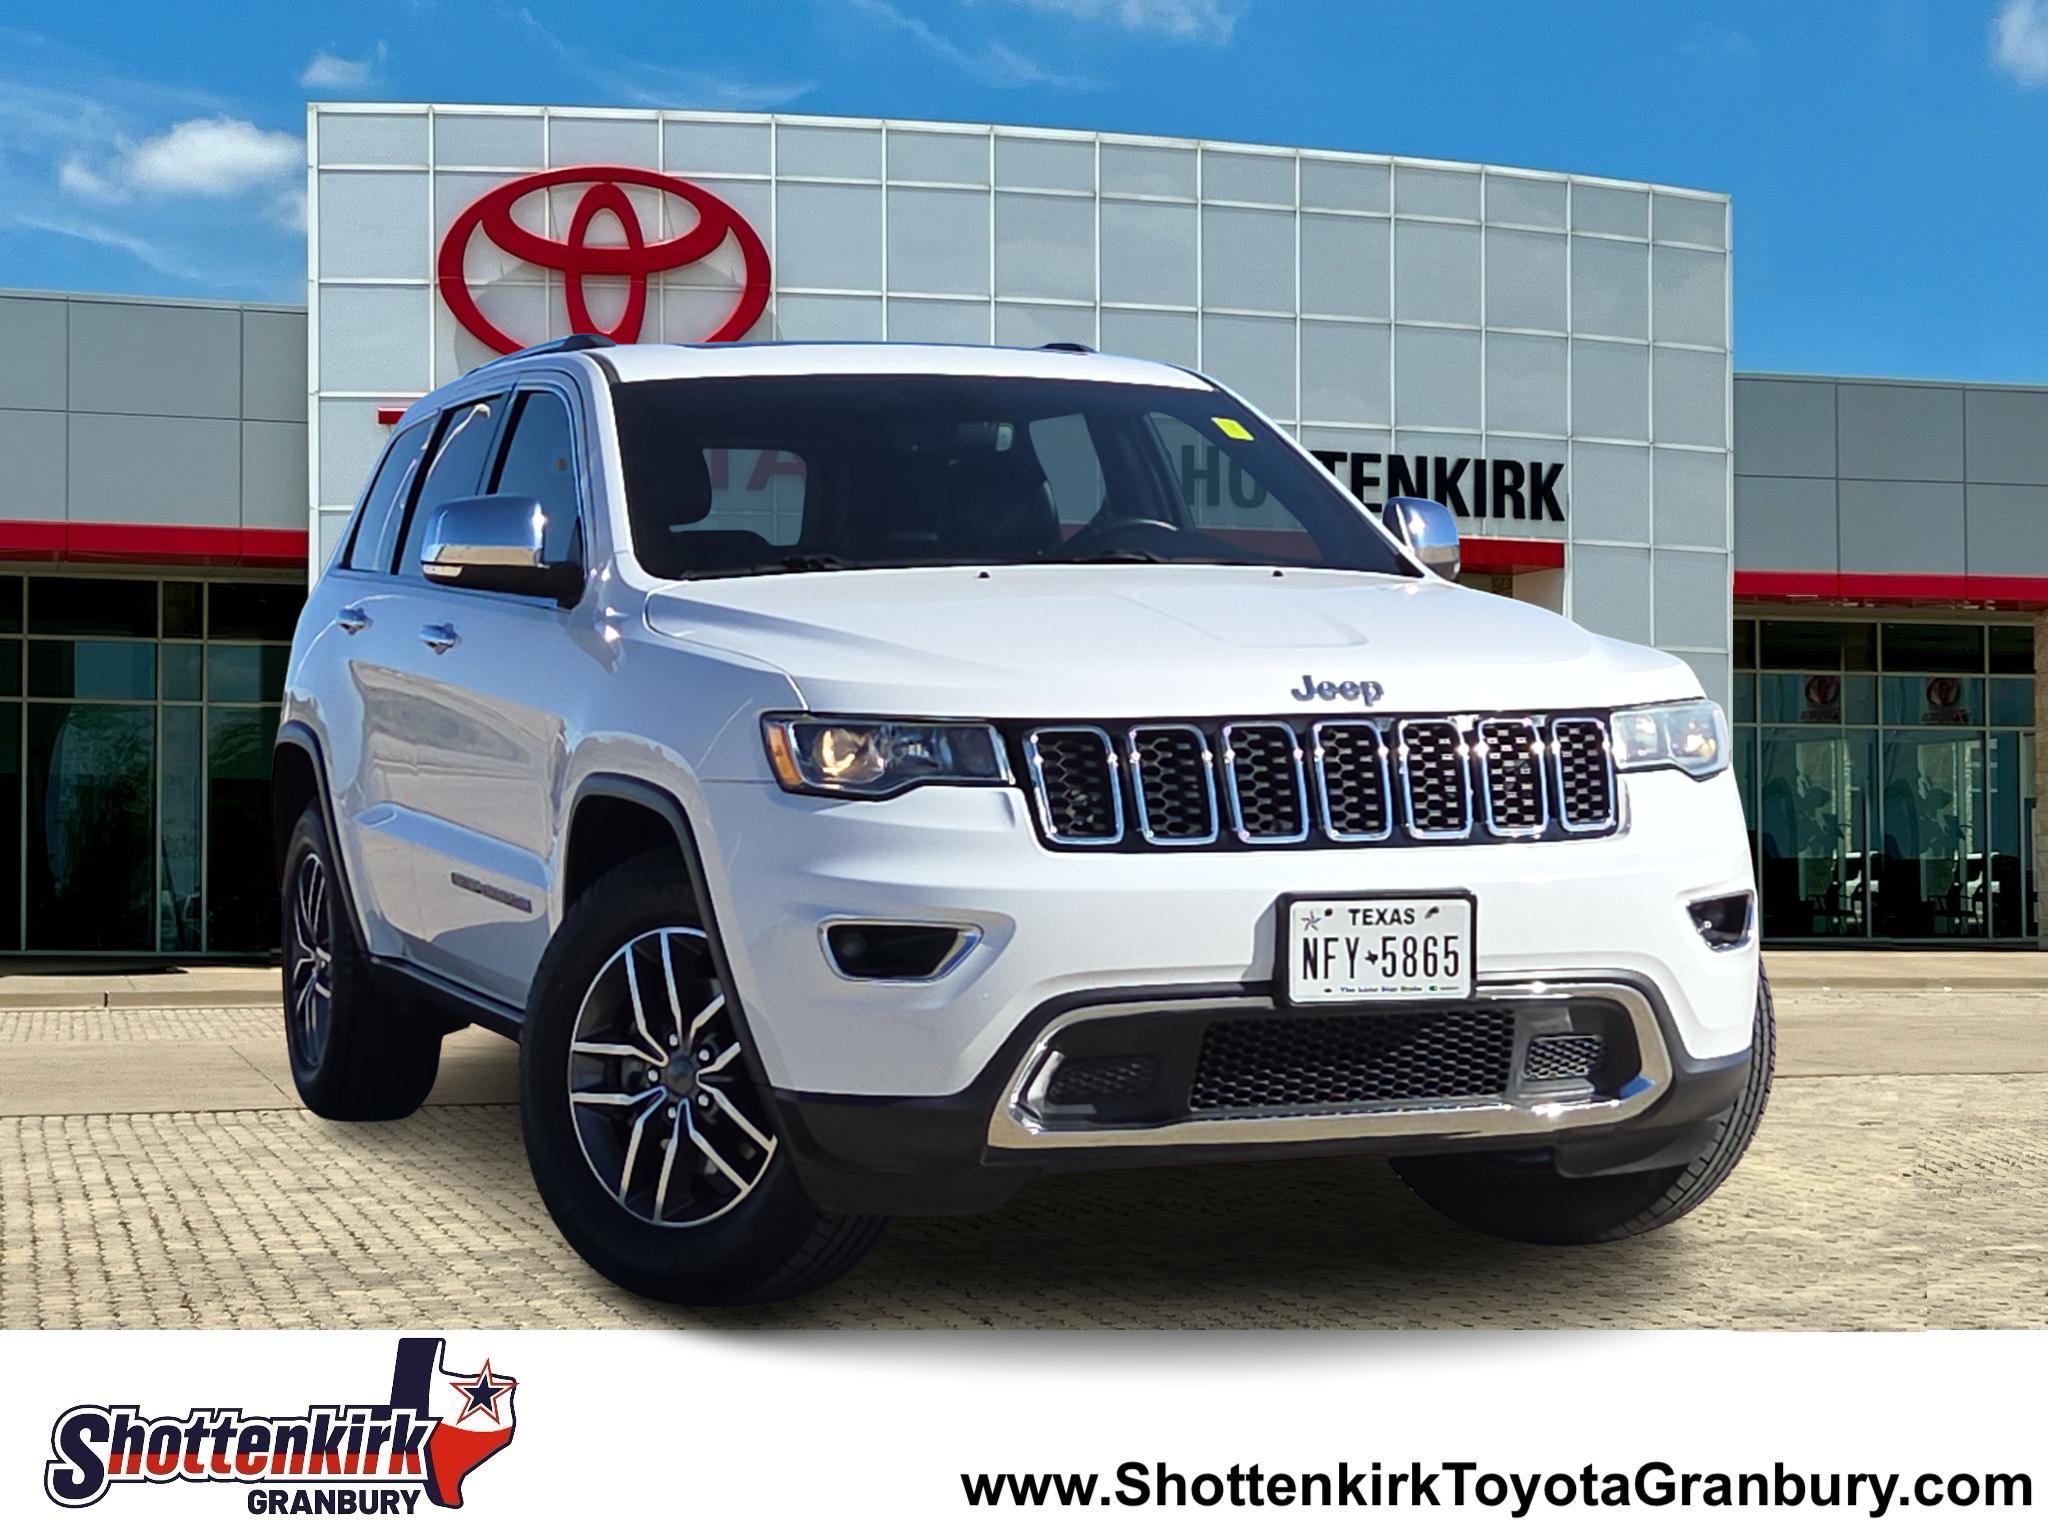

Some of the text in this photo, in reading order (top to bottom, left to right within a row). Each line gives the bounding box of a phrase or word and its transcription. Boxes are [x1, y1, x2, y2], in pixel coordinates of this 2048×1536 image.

[1290, 674, 1385, 707] Jeep
[1348, 907, 1416, 926] TEXAS
[1302, 935, 1460, 980] NFY 5865
